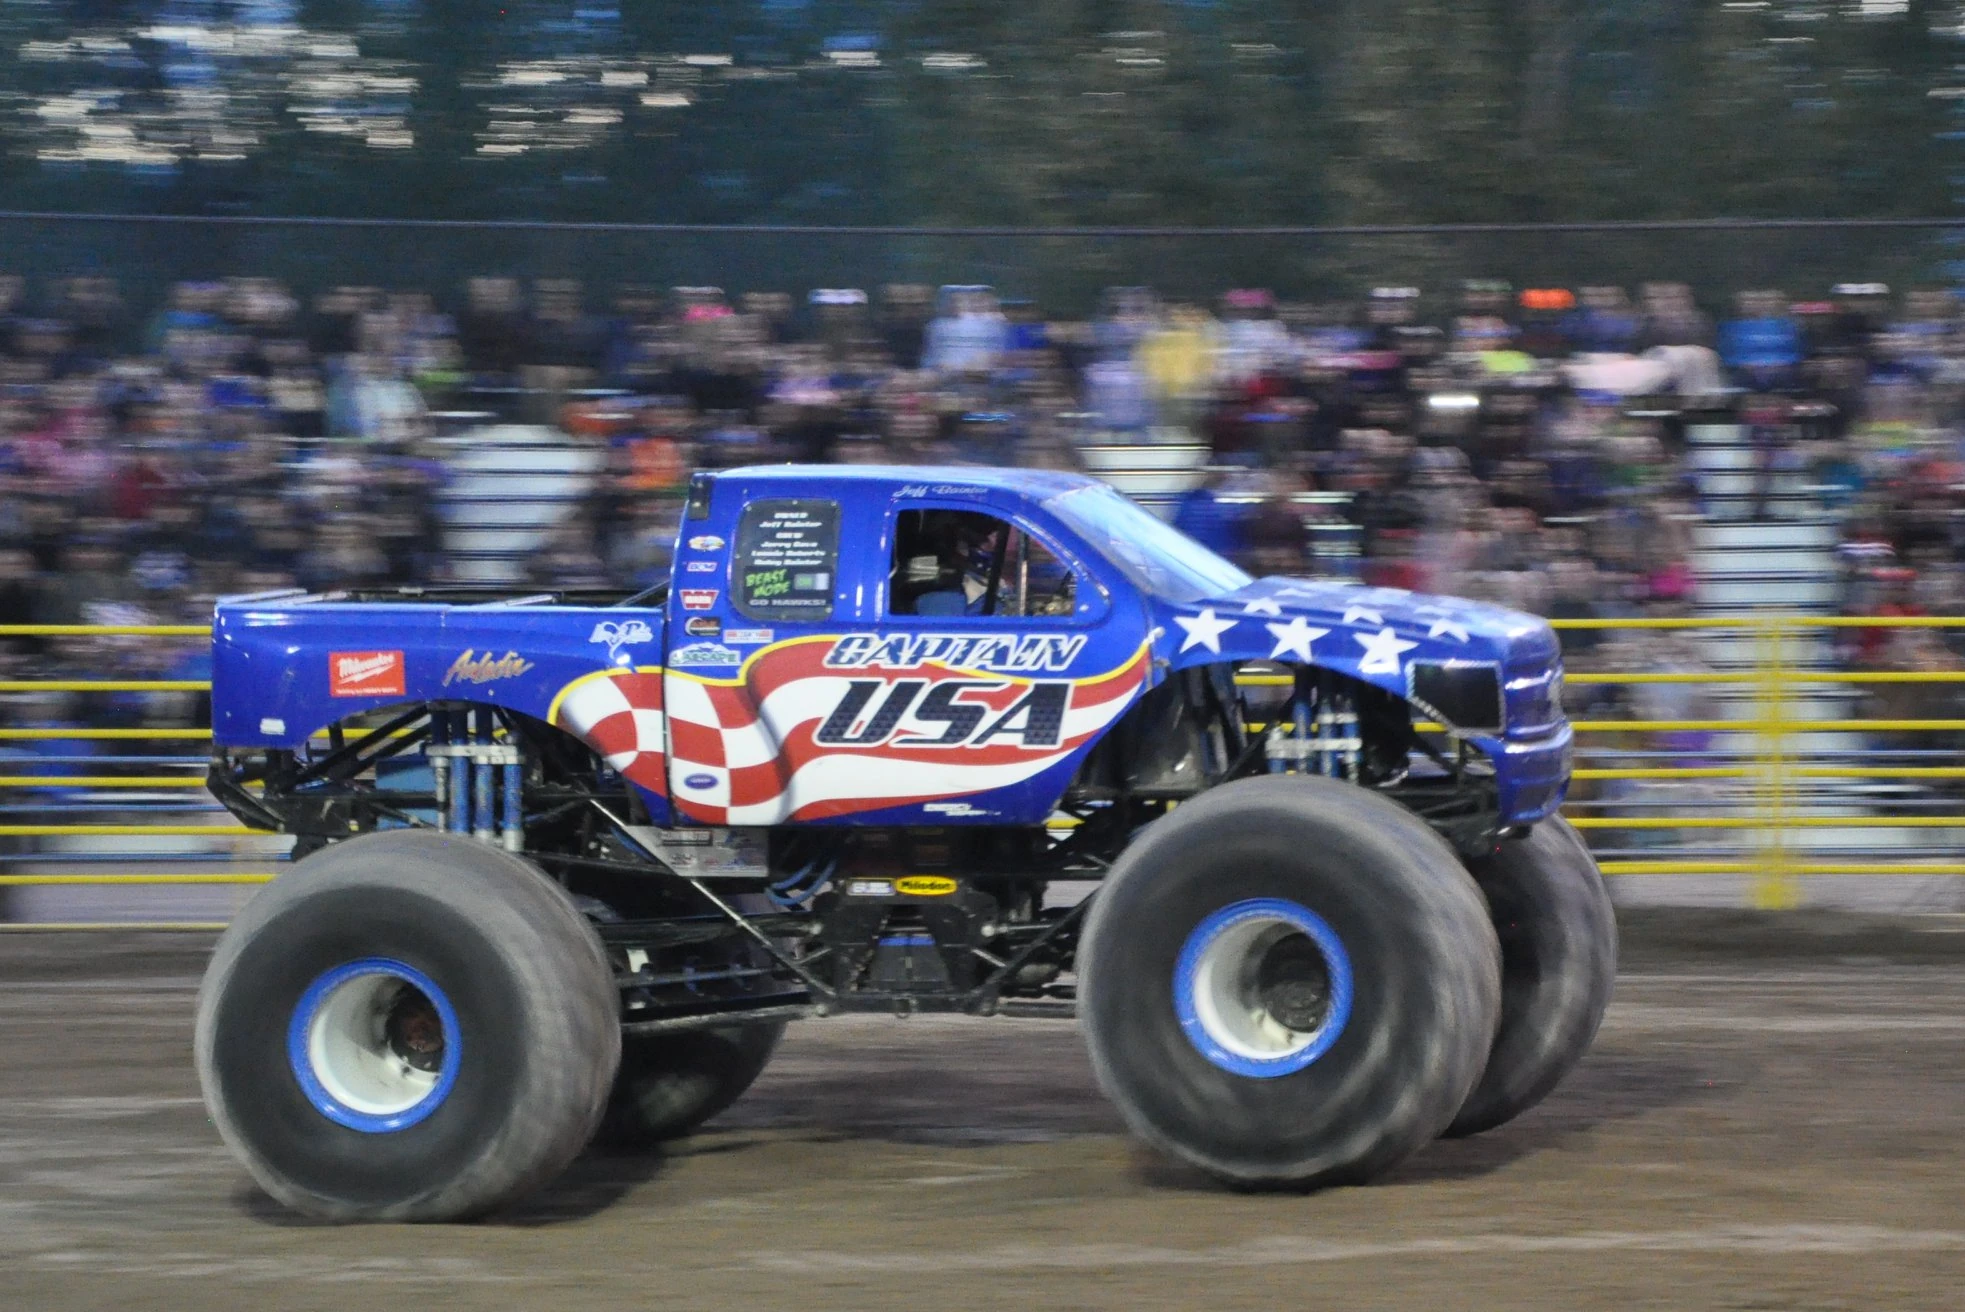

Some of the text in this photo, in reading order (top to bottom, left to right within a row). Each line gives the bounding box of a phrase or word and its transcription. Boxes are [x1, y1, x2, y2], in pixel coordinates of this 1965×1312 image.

[745, 569, 787, 587] BEAST
[753, 581, 791, 598] MODE
[822, 632, 1089, 672] CAPTAIN
[811, 677, 1076, 750] USA
